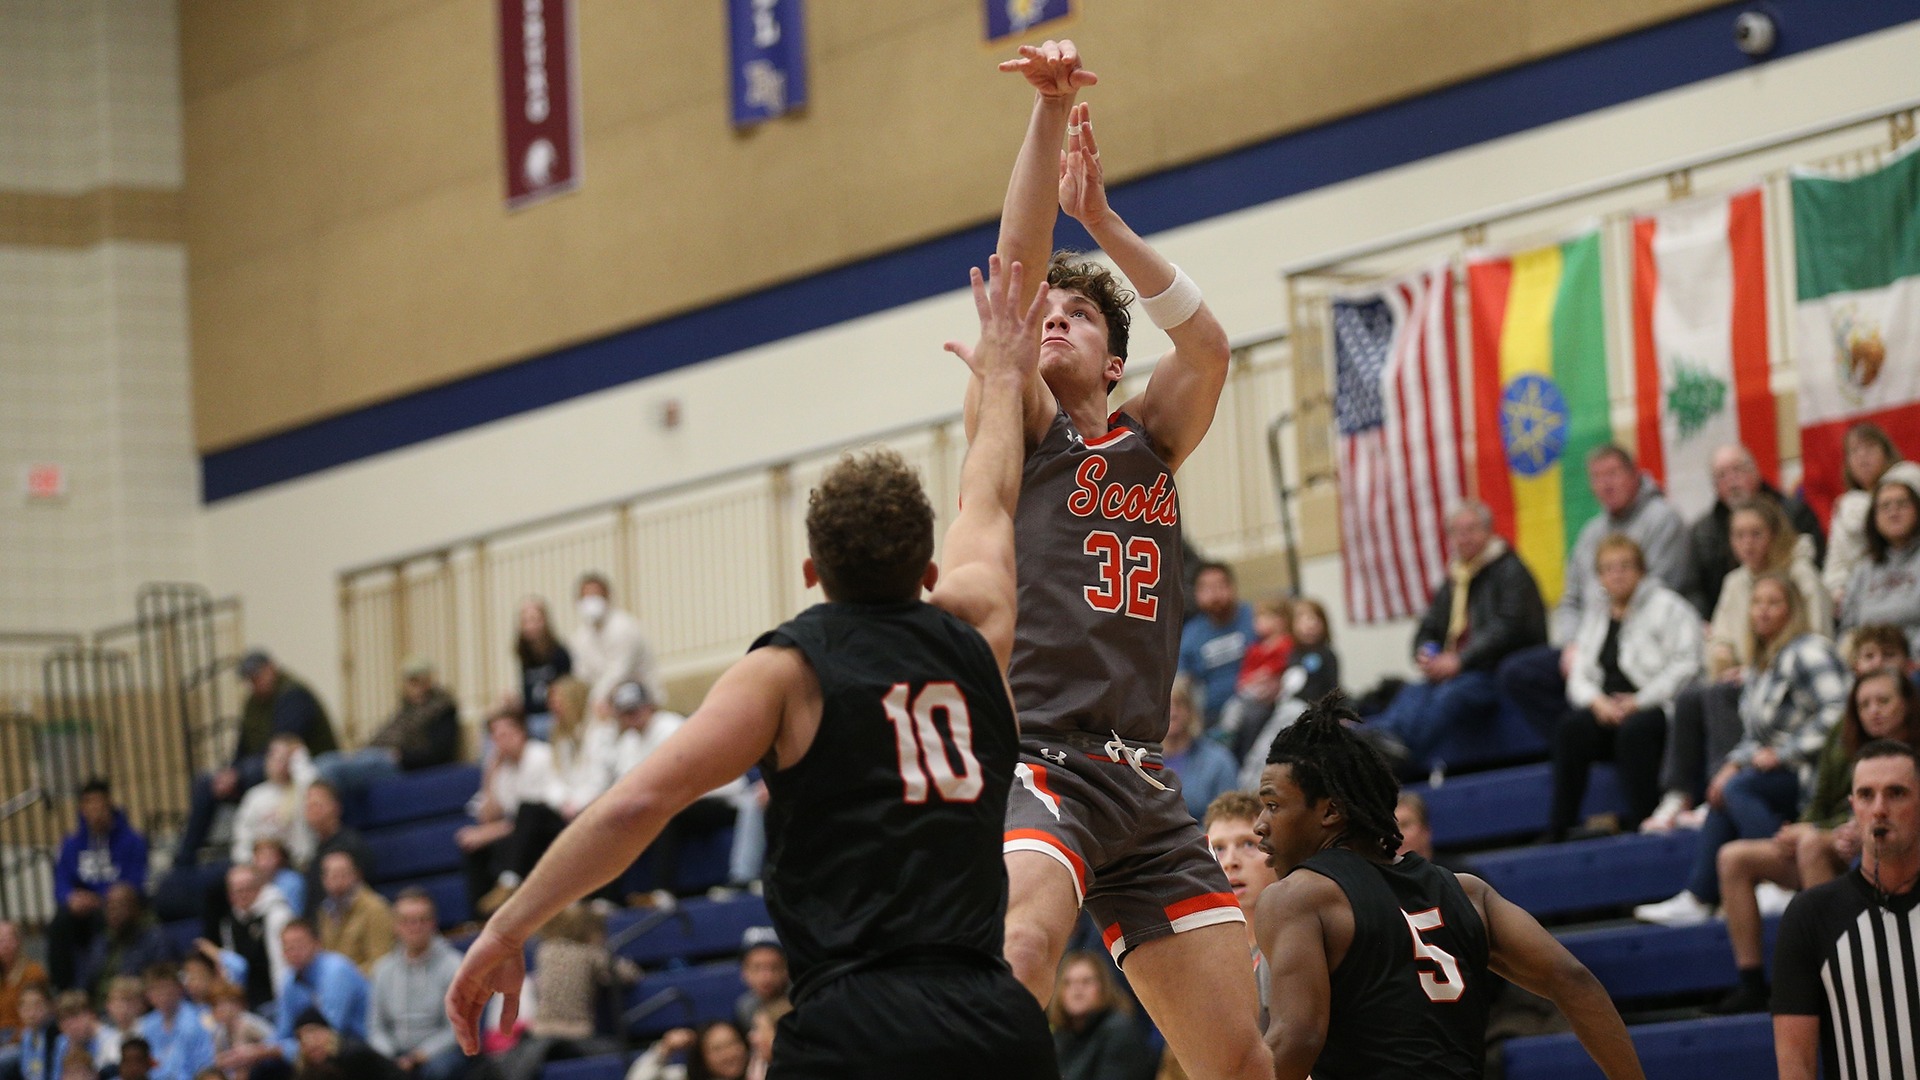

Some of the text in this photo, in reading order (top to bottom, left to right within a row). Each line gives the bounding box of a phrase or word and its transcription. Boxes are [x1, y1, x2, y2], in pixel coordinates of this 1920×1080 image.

[1067, 454, 1177, 526] Scots
[1083, 529, 1161, 622] 32
[881, 681, 985, 804] 10
[1399, 906, 1466, 1003] 5
